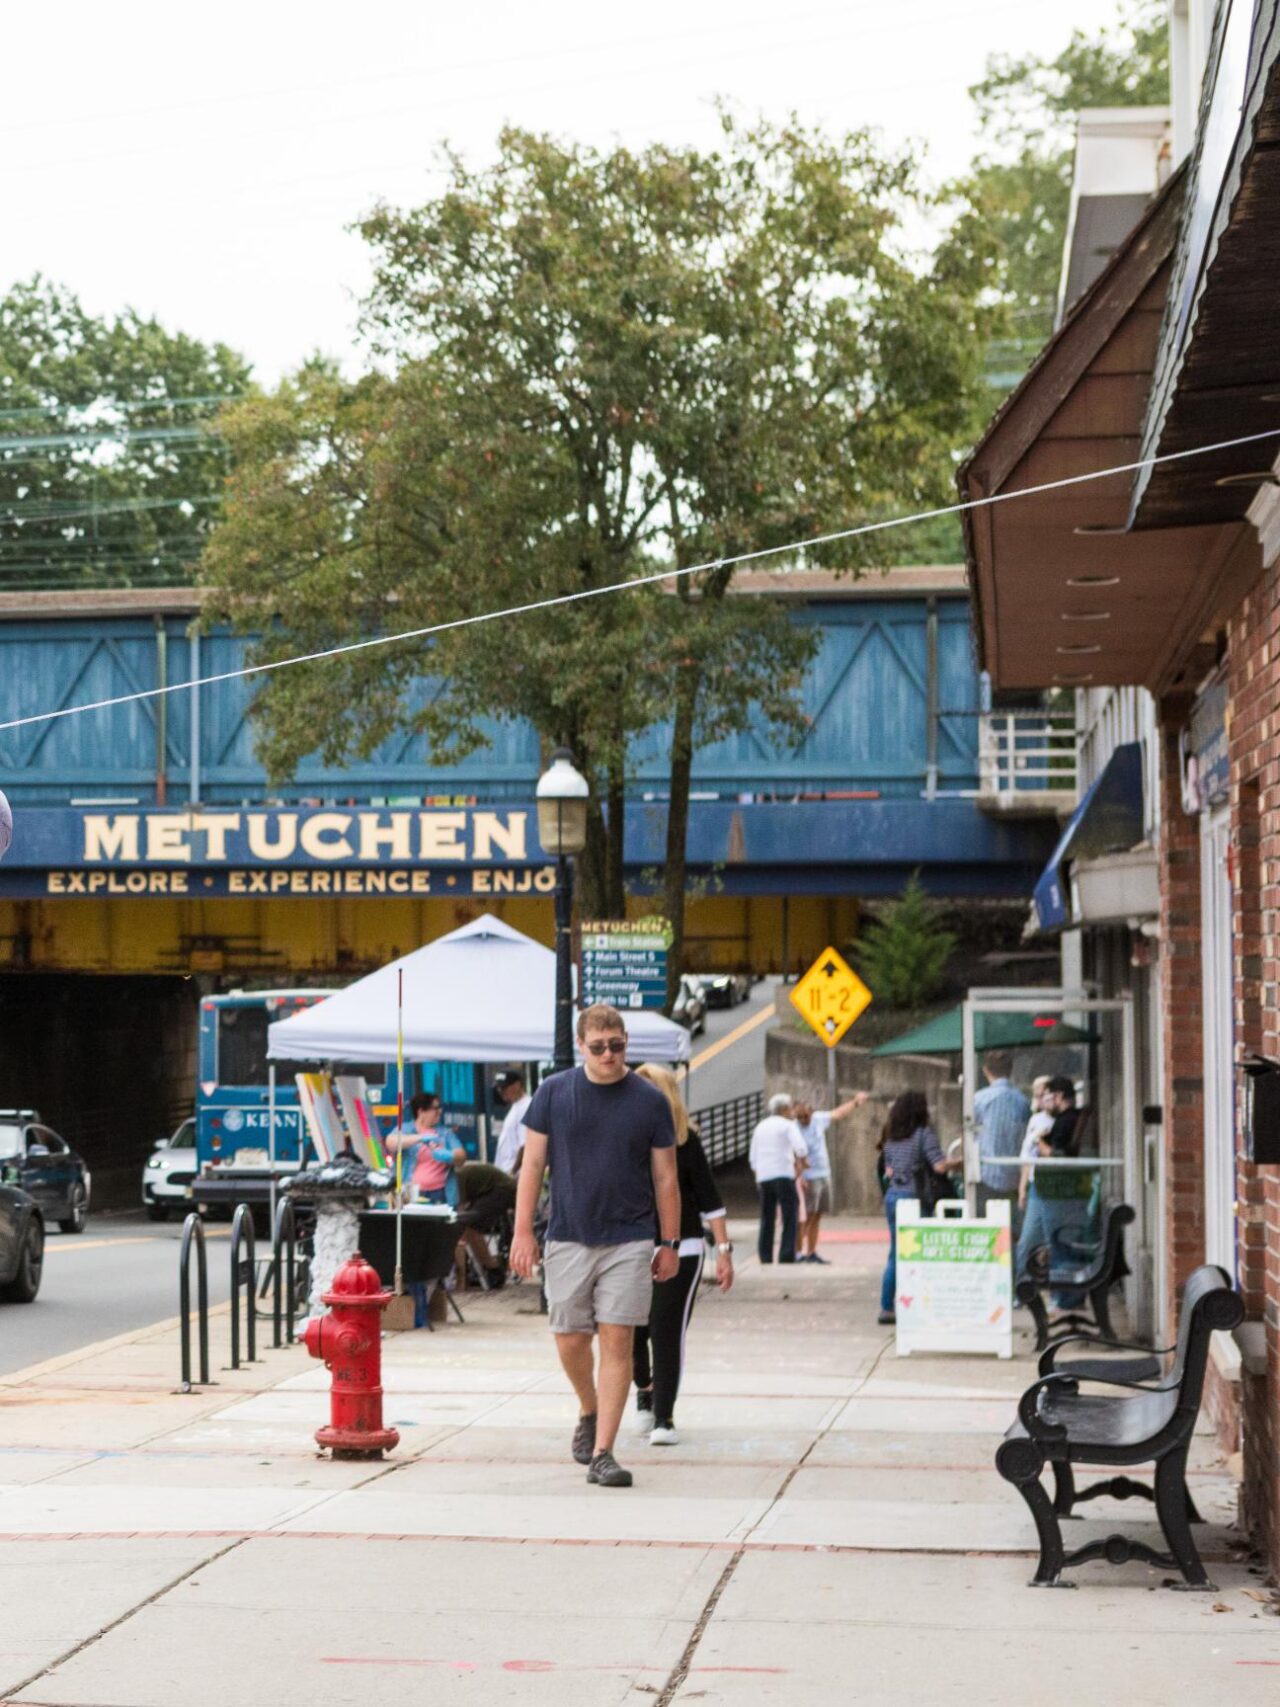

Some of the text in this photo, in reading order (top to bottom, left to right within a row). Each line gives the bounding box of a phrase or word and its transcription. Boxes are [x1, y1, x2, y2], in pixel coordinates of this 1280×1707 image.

[82, 811, 528, 862] METUCHEN
[47, 866, 557, 894] EXPLORE EXPERIENCE ENJO
[581, 921, 662, 933] METUCHEN
[595, 951, 618, 961] Main
[619, 951, 647, 961] Street
[595, 965, 623, 976] Forum
[595, 982, 640, 992] Greenway
[246, 1112, 297, 1128] KEAN
